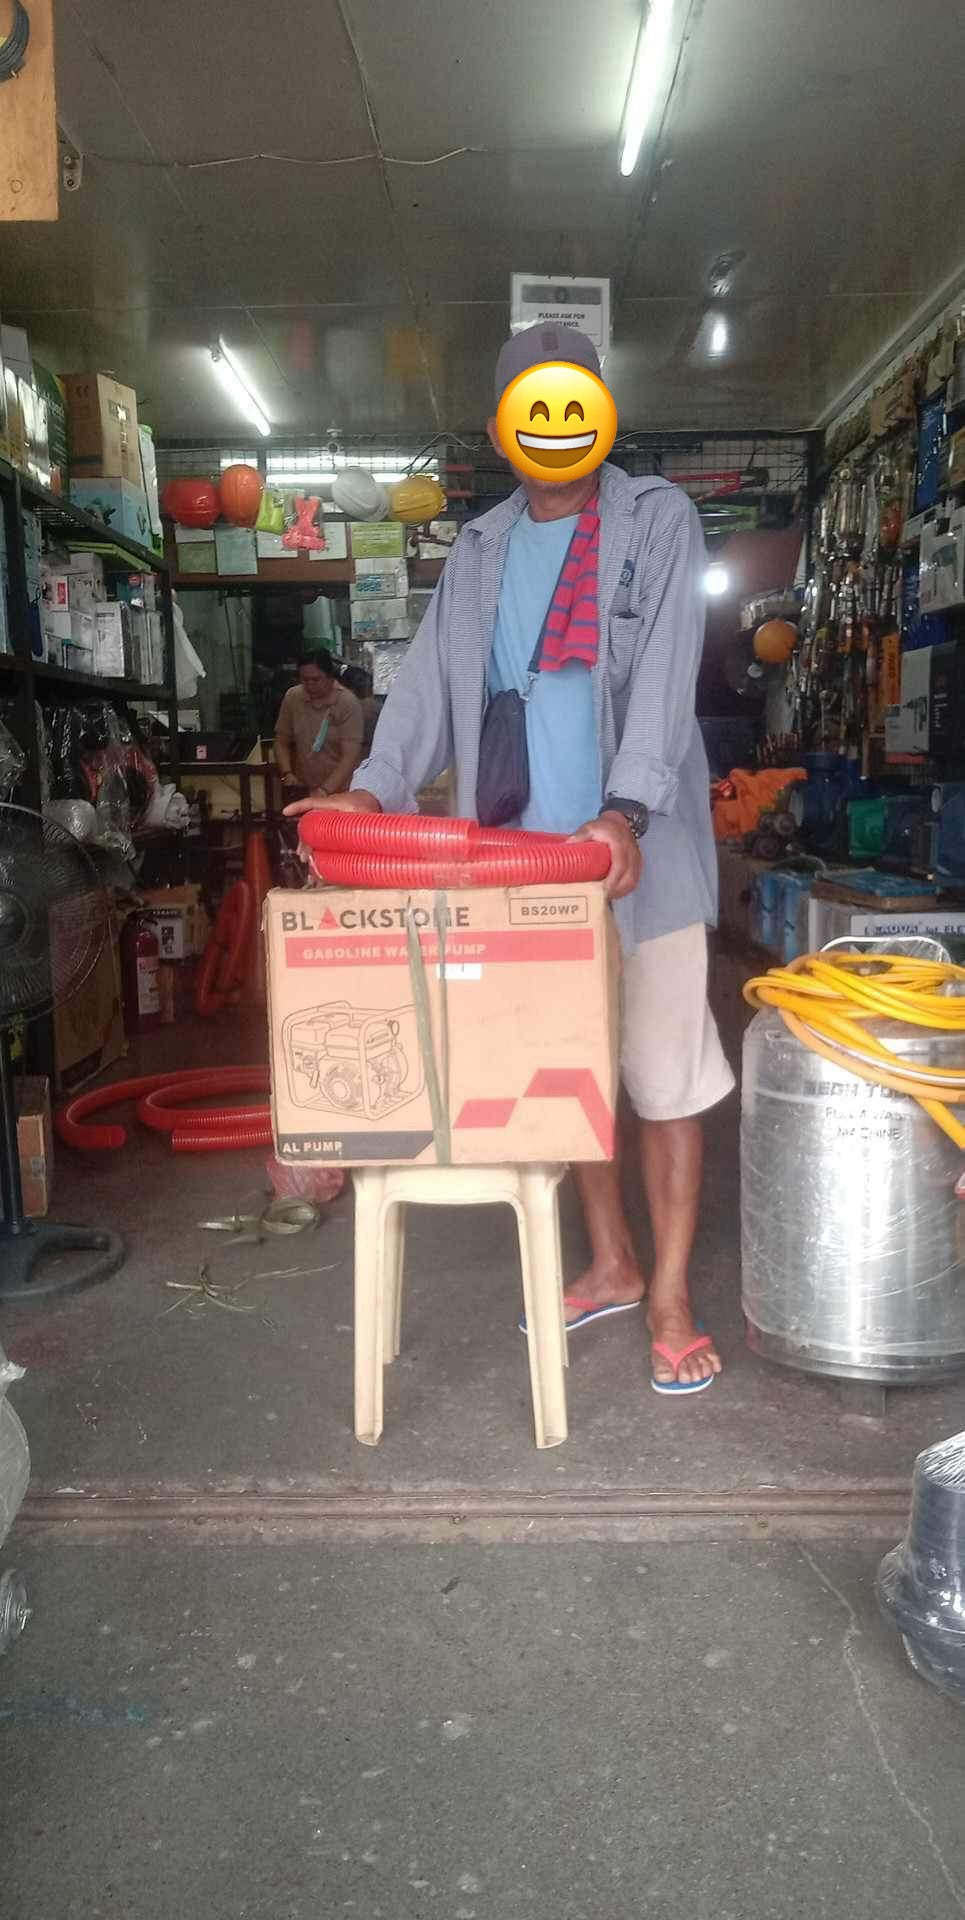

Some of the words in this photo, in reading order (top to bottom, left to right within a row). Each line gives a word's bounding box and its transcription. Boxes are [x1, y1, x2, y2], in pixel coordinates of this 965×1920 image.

[520, 904, 579, 917] BS20WP
[303, 946, 381, 961] GASOLINE
[385, 944, 438, 959] WAER
[444, 943, 488, 956] PUMP
[282, 1142, 300, 1153] AL
[303, 1141, 343, 1152] PUMP
